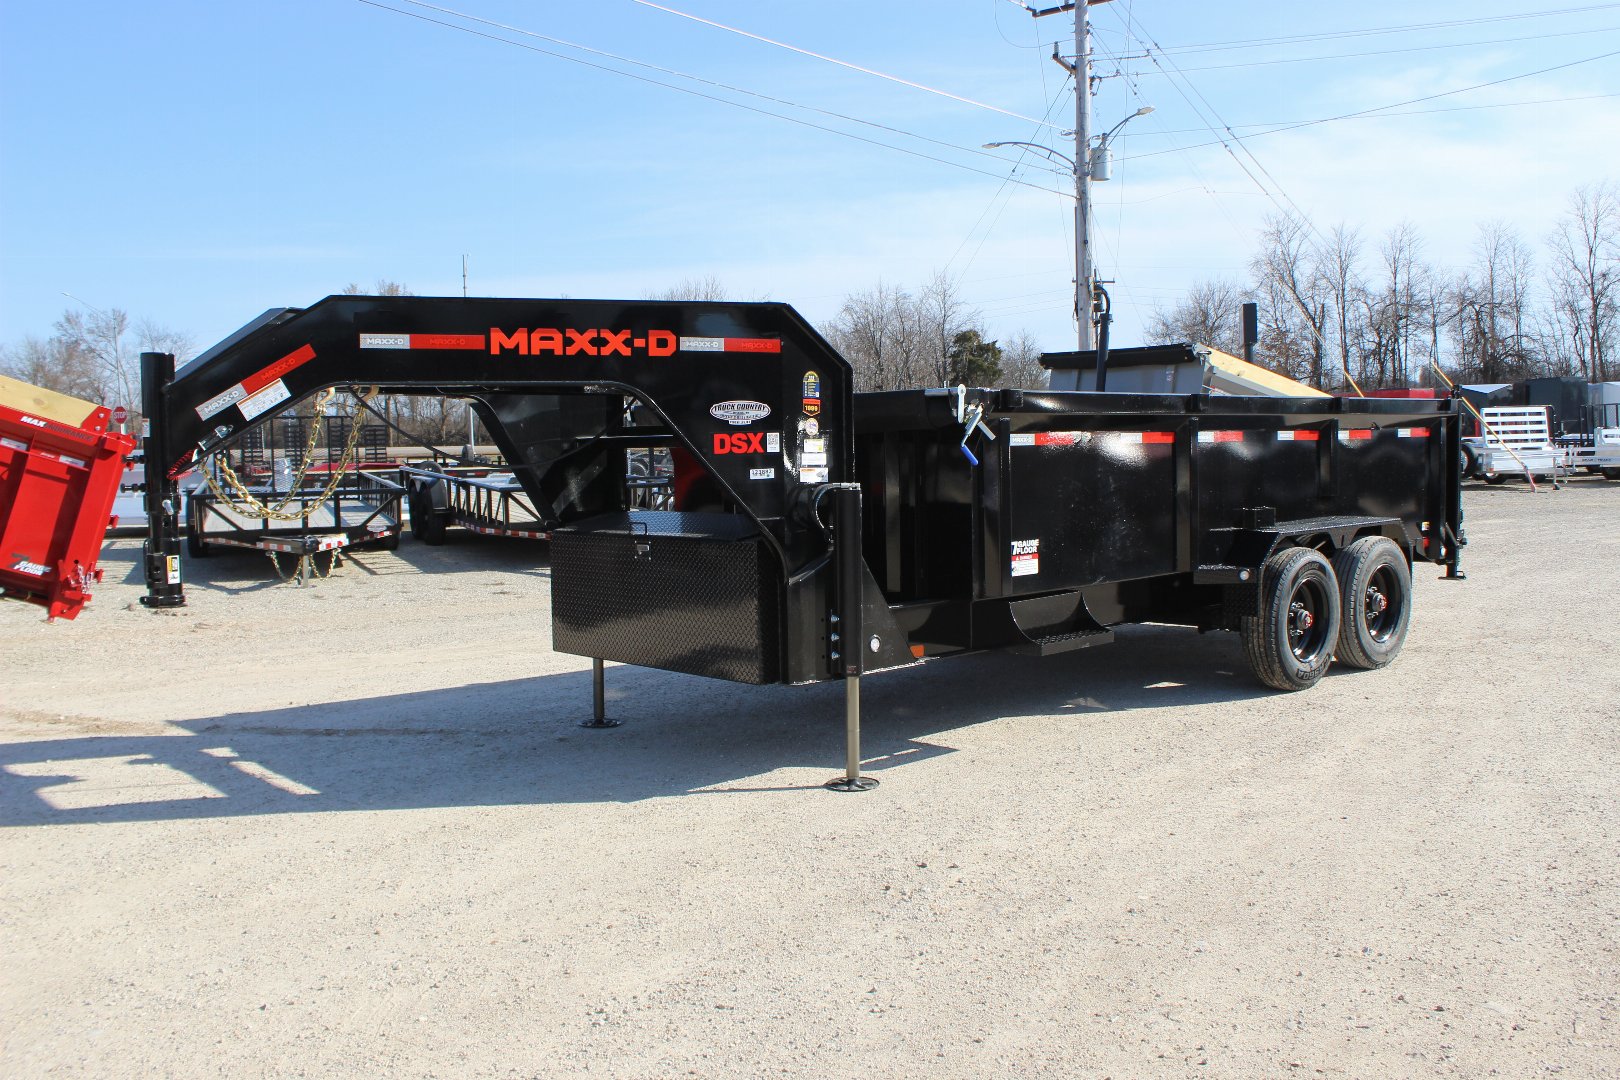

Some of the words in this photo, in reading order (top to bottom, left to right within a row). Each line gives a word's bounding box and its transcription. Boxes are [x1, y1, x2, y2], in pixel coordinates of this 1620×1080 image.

[429, 338, 466, 346] MAXX-D
[490, 327, 677, 357] MAXX-D
[261, 358, 296, 381] MAXX-D
[204, 390, 240, 414] MAXX-D
[713, 403, 736, 412] TRUCK
[736, 403, 767, 411] COUNTRY
[20, 415, 48, 428] MAX
[113, 411, 128, 419] STOP
[713, 432, 765, 455] DSX
[1011, 541, 1018, 555] 7
[1018, 539, 1040, 548] GAUGE
[1017, 546, 1038, 555] FLOOR
